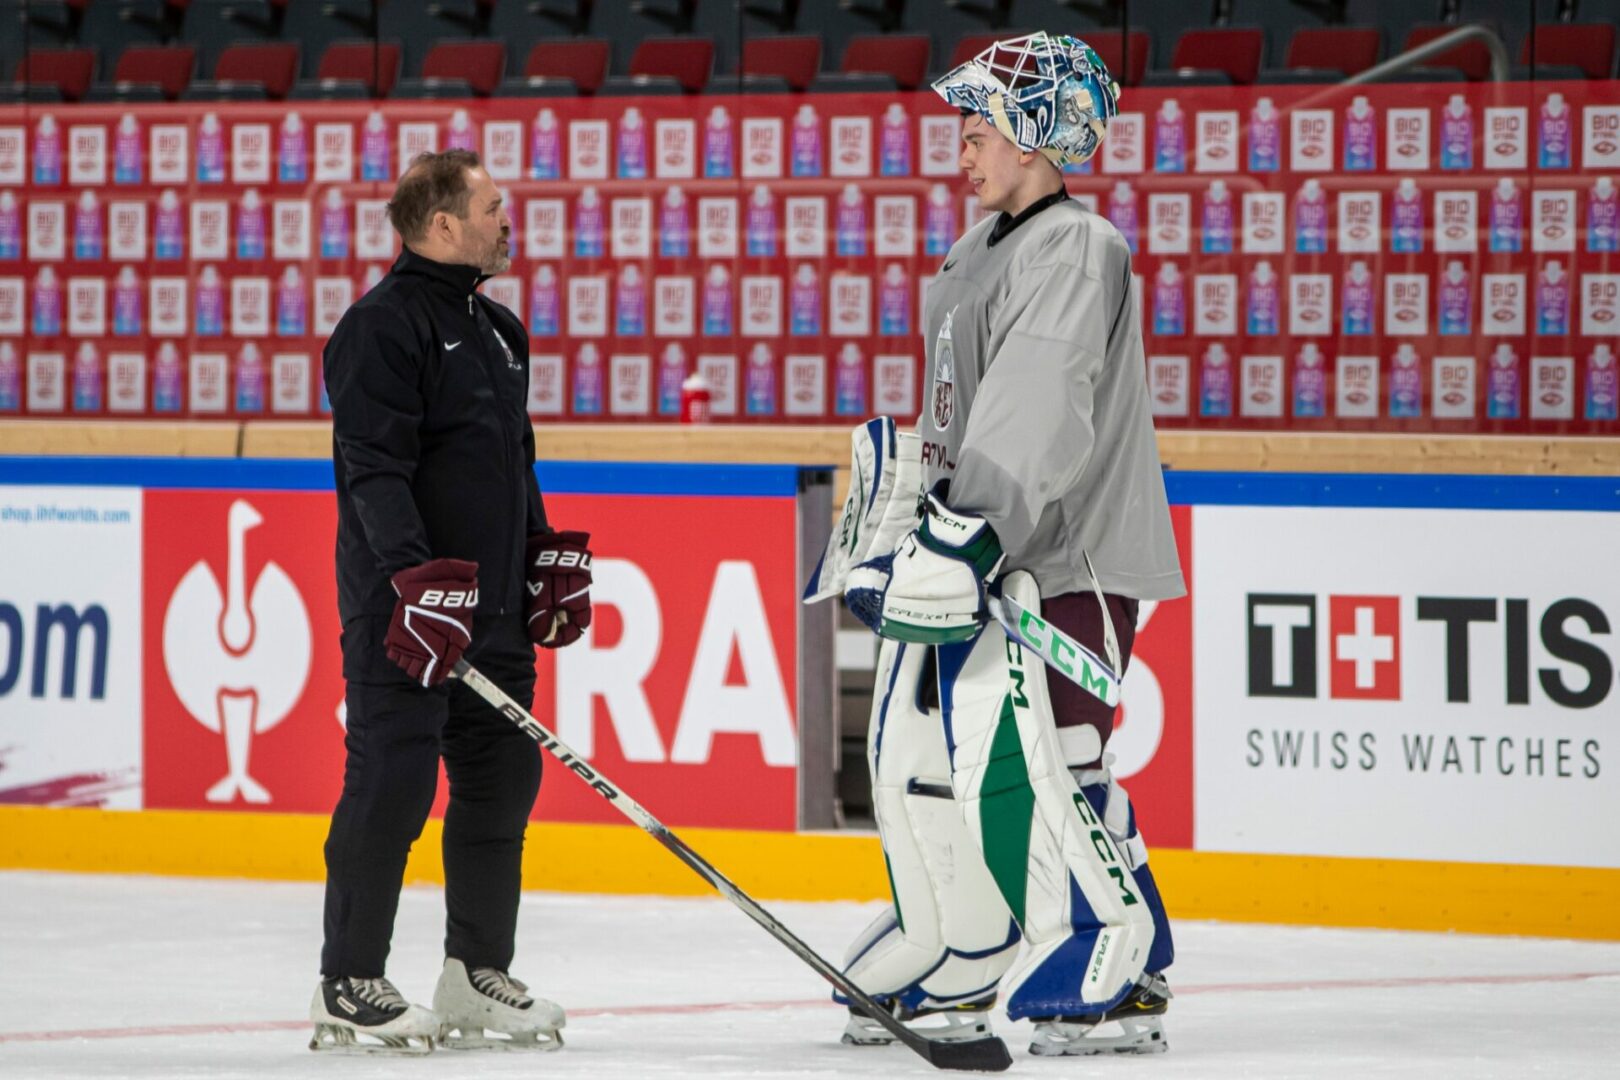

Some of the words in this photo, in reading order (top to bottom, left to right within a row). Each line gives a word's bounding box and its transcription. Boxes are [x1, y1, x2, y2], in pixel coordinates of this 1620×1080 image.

[1006, 636, 1030, 709] CM
[1018, 608, 1110, 703] CCM
[1246, 729, 1377, 771] SWISS
[1402, 734, 1602, 779] WATCHES
[1072, 791, 1139, 907] CCM
